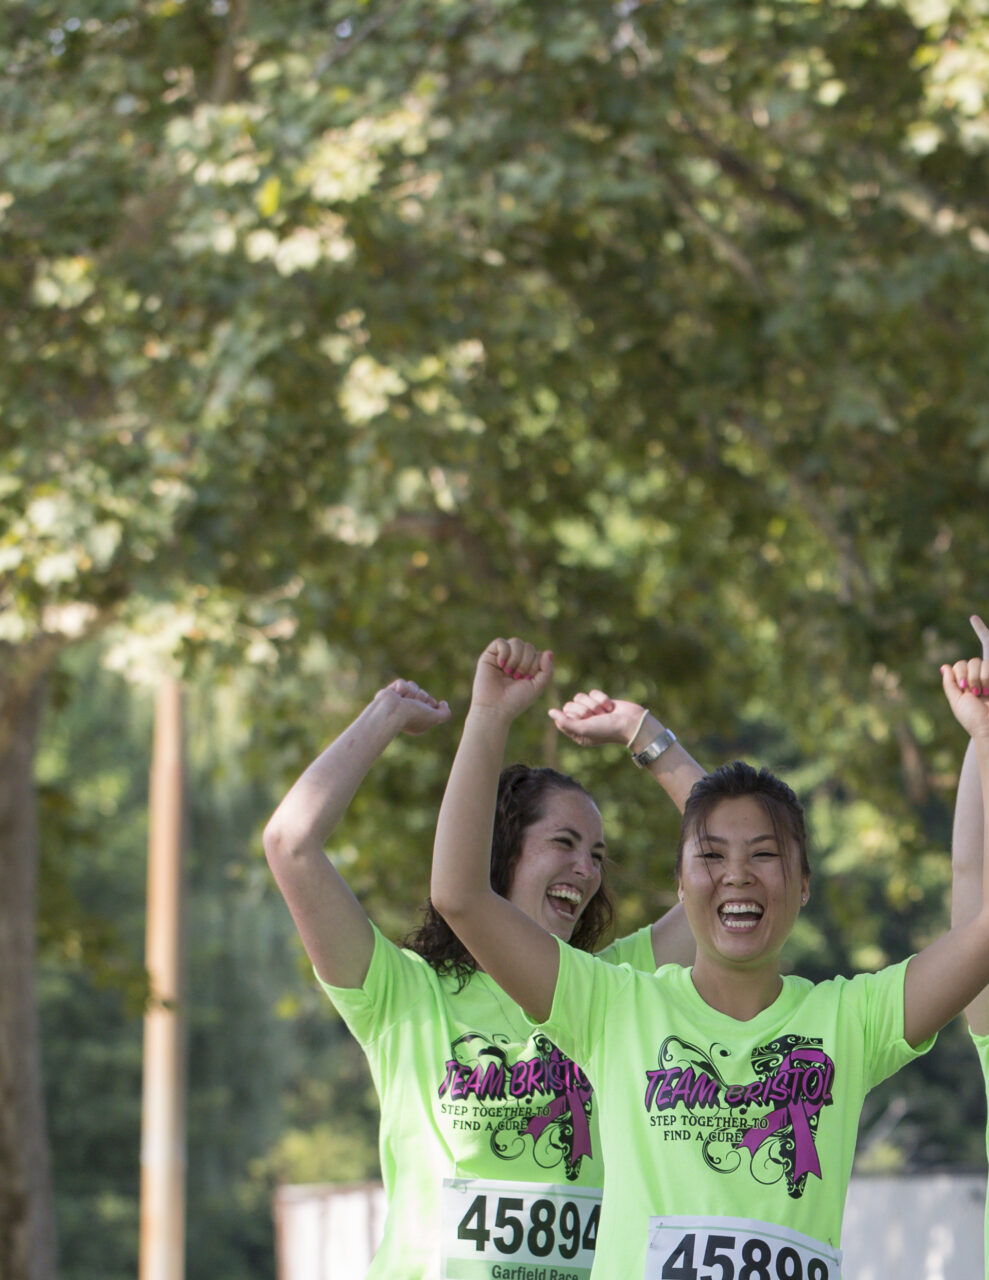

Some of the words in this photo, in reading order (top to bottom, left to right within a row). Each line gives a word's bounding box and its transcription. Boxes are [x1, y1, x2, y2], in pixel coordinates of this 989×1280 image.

[439, 1060, 507, 1101] TEAM
[645, 1066, 721, 1112] TEAM
[725, 1063, 834, 1107] BRISTOL
[441, 1104, 467, 1116] STEP
[473, 1106, 533, 1117] TOGETHER
[536, 1106, 549, 1117] TO
[453, 1120, 480, 1131] FIND
[485, 1121, 493, 1131] A
[497, 1120, 528, 1131] CURE
[650, 1115, 676, 1127] STEP
[681, 1115, 748, 1128] TOGETHER
[752, 1118, 769, 1129] TO
[664, 1130, 691, 1141] FIND
[696, 1131, 705, 1141] A
[709, 1131, 743, 1142] CURE
